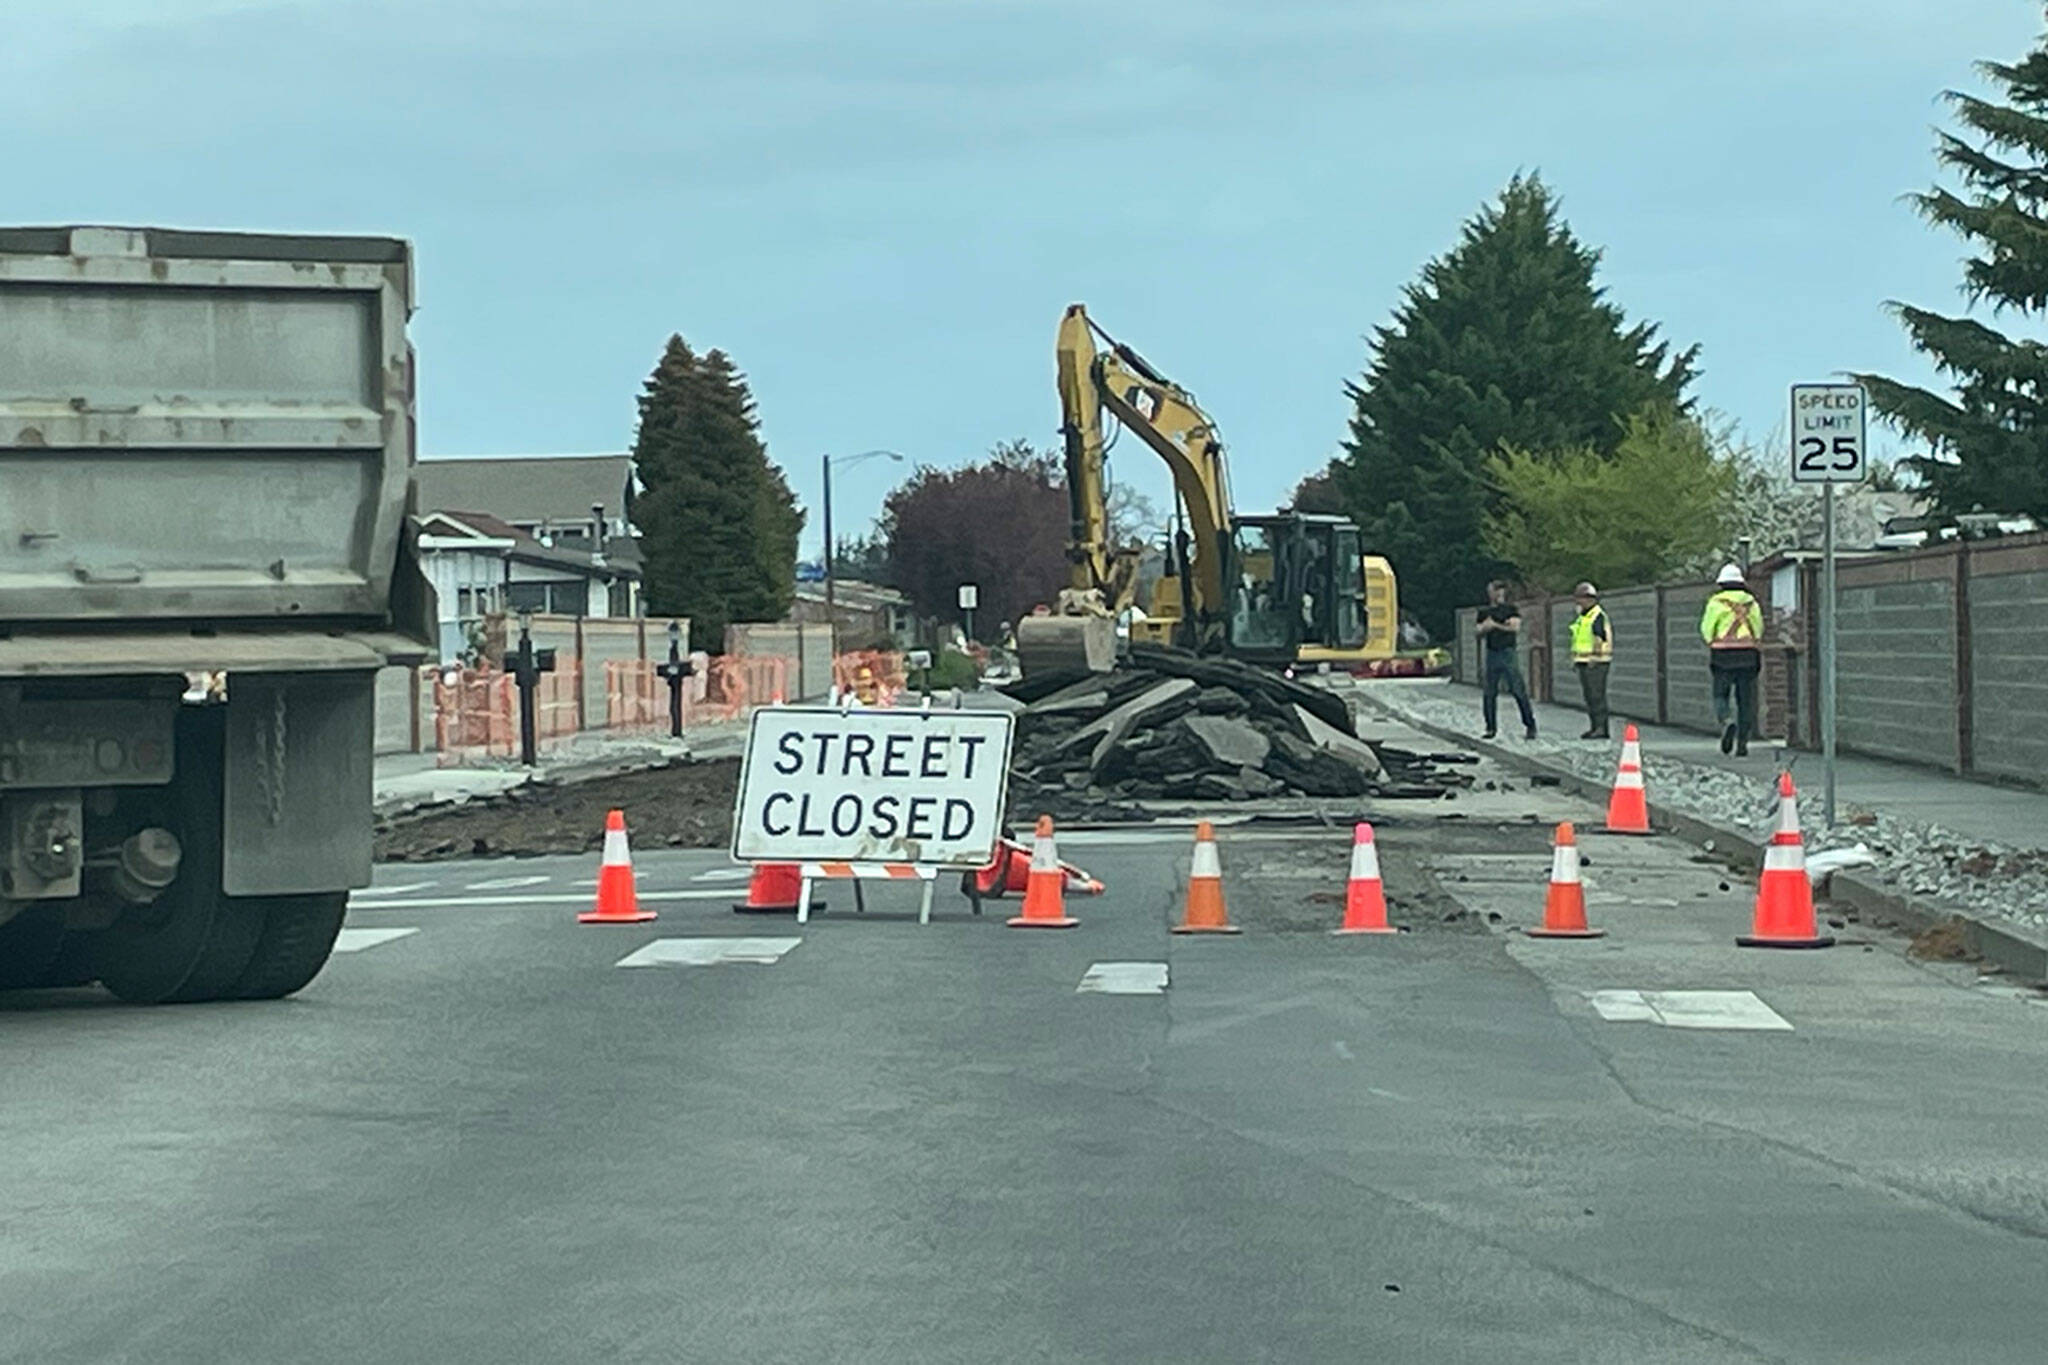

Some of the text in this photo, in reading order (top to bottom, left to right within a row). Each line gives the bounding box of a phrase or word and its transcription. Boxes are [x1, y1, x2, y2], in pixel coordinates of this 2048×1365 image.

[1799, 394, 1859, 410] SPEED
[1804, 416, 1852, 430] LIMIT
[1800, 437, 1859, 470] 25
[774, 731, 986, 779] STREET
[762, 792, 975, 841] CLOSED
